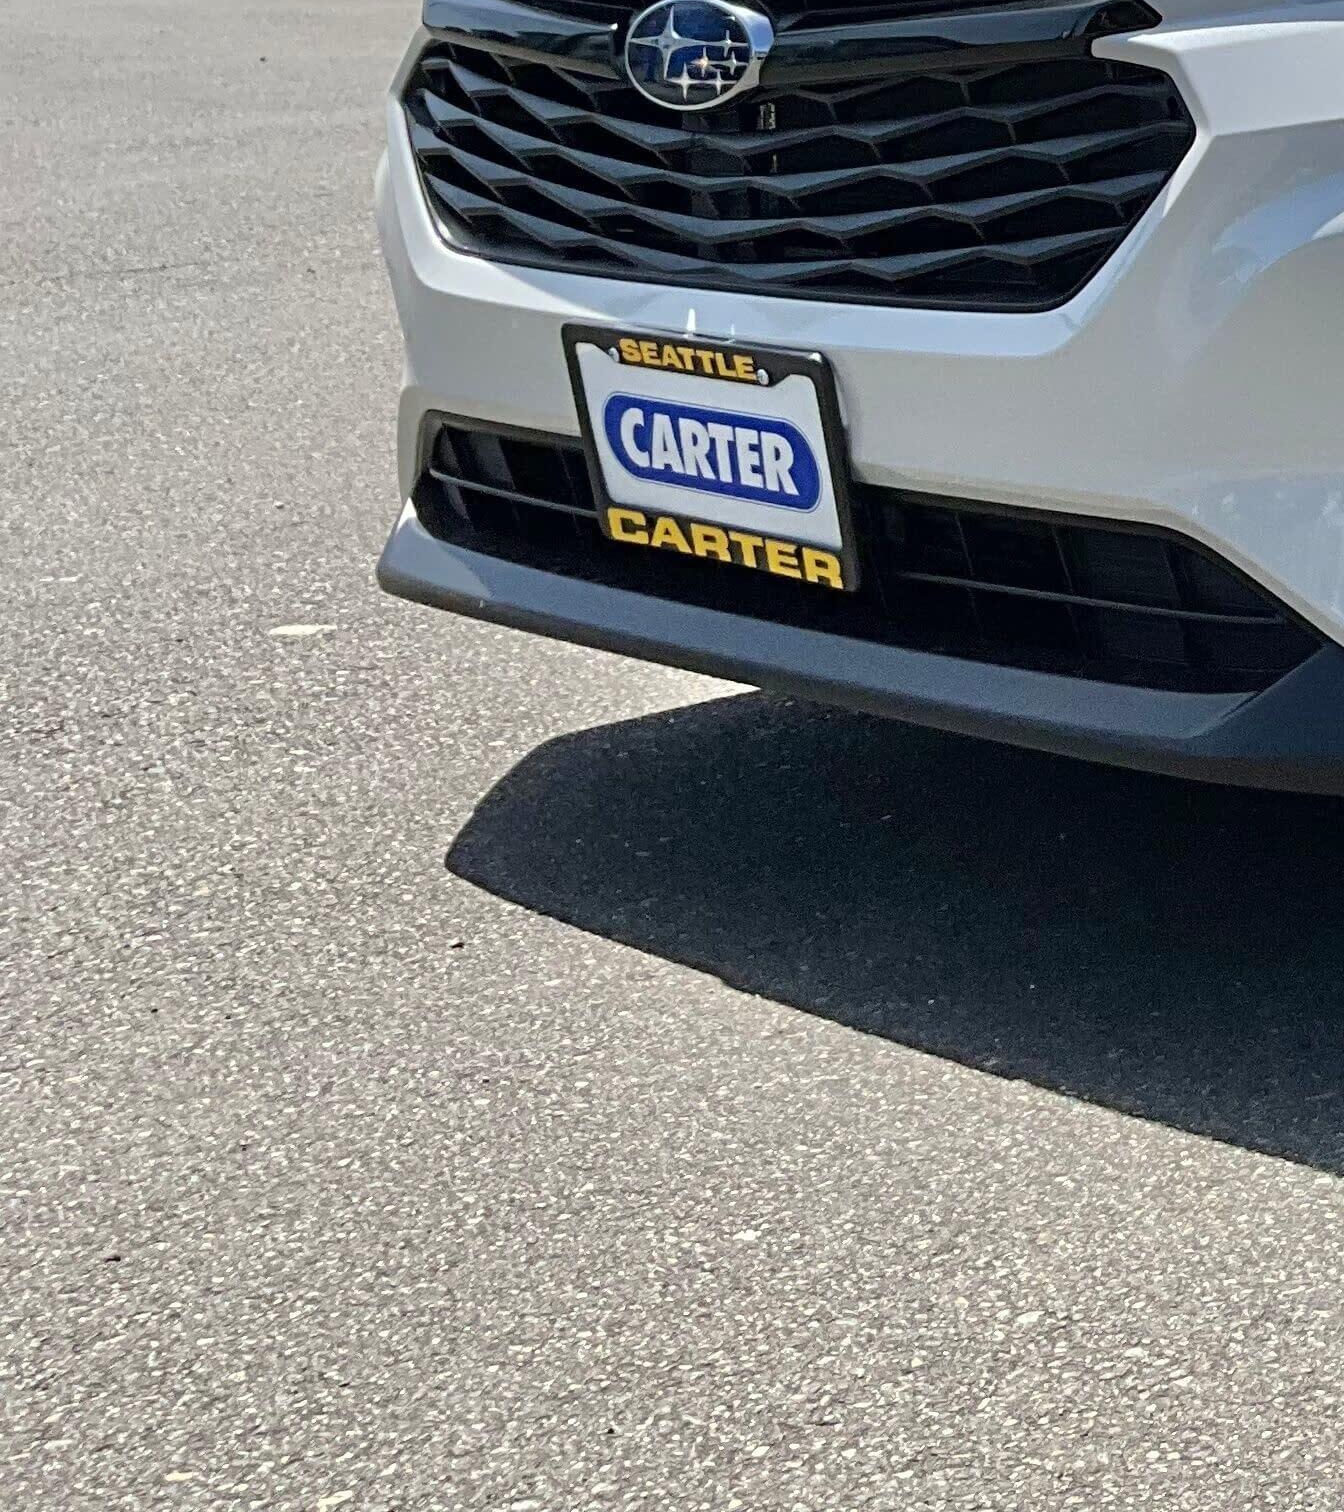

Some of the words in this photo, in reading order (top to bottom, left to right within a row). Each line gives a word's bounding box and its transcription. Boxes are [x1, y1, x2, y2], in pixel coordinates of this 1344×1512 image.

[619, 338, 758, 381] SEATTLE
[620, 407, 799, 496] CARTER
[607, 507, 844, 590] CARTER
